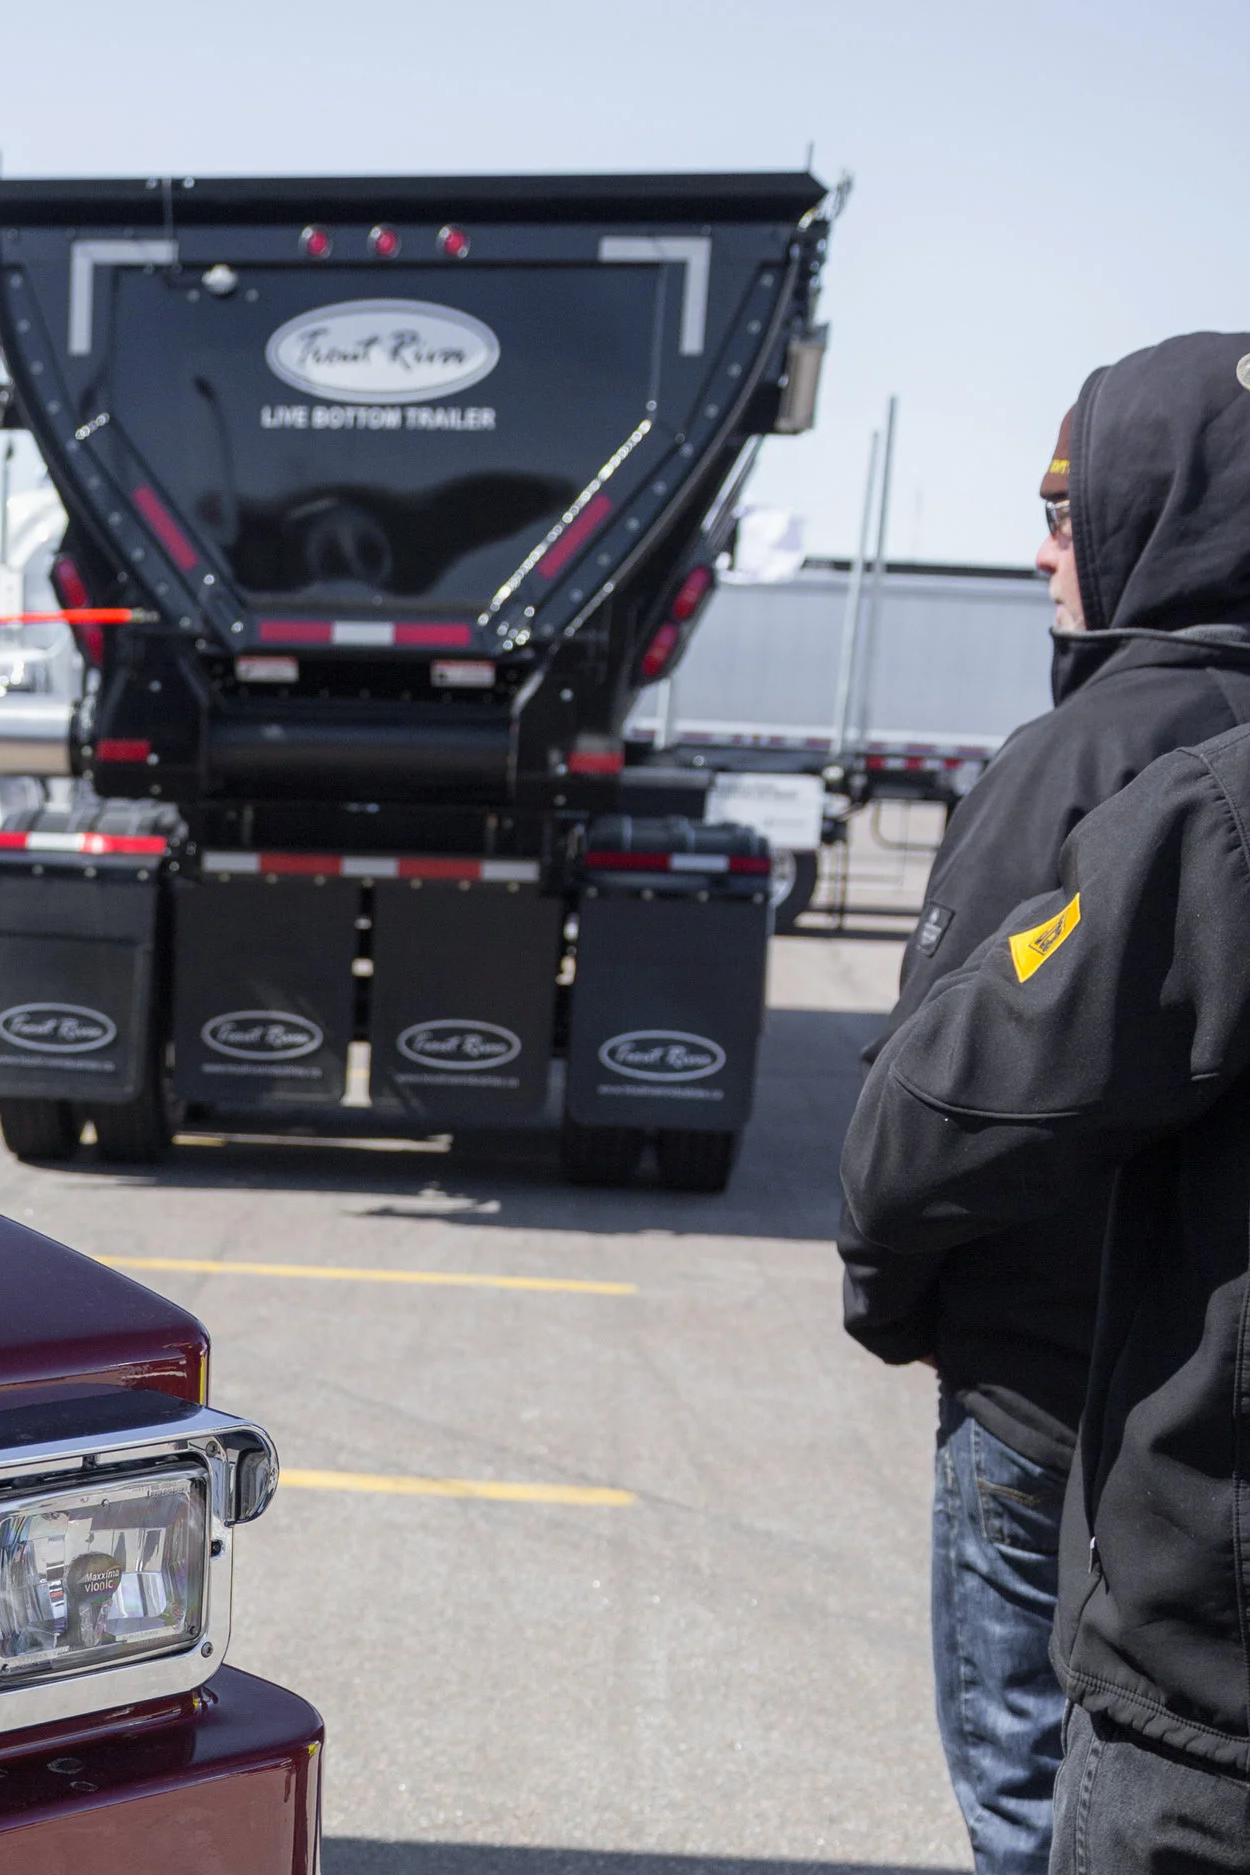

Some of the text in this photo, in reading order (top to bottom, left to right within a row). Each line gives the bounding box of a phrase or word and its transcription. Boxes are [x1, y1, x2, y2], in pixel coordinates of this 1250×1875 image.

[260, 404, 497, 431] LIVE BOTTOM TRAILER
